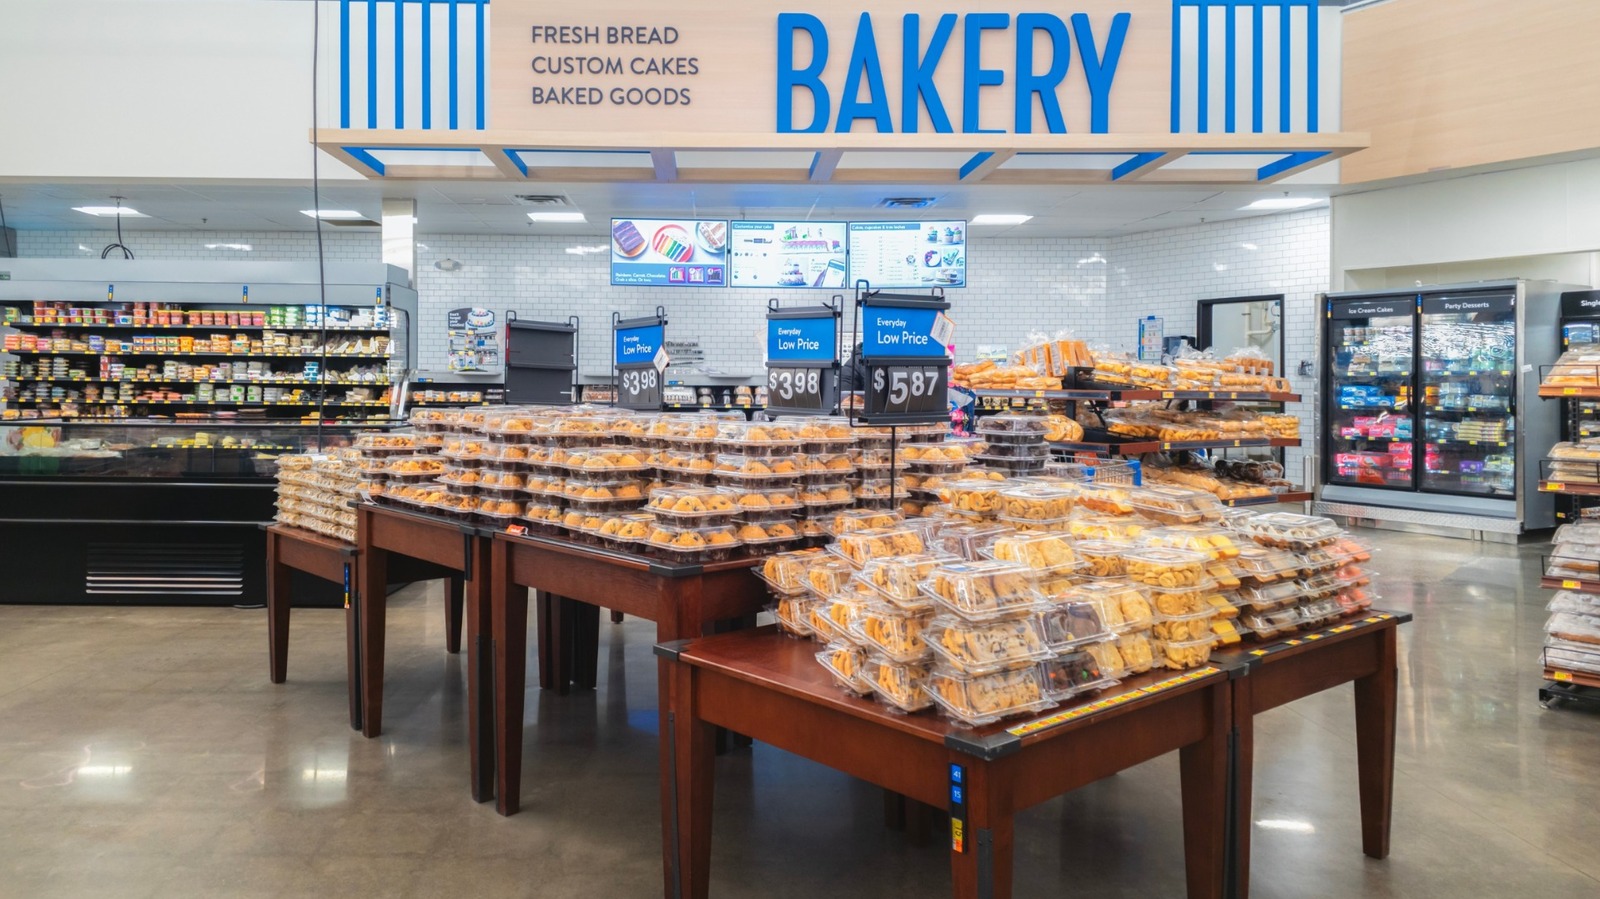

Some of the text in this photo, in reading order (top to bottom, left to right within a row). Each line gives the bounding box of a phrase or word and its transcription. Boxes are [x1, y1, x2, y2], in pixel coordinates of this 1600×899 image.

[532, 26, 678, 44] FRESH BREAD
[532, 56, 699, 75] CUSTOM CAKES
[777, 12, 1131, 132] BAKERY
[532, 87, 691, 105] BAKED GOODS
[1358, 306, 1376, 314] Cream
[1445, 301, 1490, 311] Party Desserts
[877, 317, 907, 327] Everyday
[623, 335, 640, 343] Everyday
[778, 328, 802, 336] Everyday
[877, 330, 929, 345] Low Price
[623, 343, 652, 355] Low Price
[778, 338, 819, 350] Low Price
[623, 370, 657, 395] $398
[769, 372, 818, 400] $398
[874, 367, 939, 404] $587
